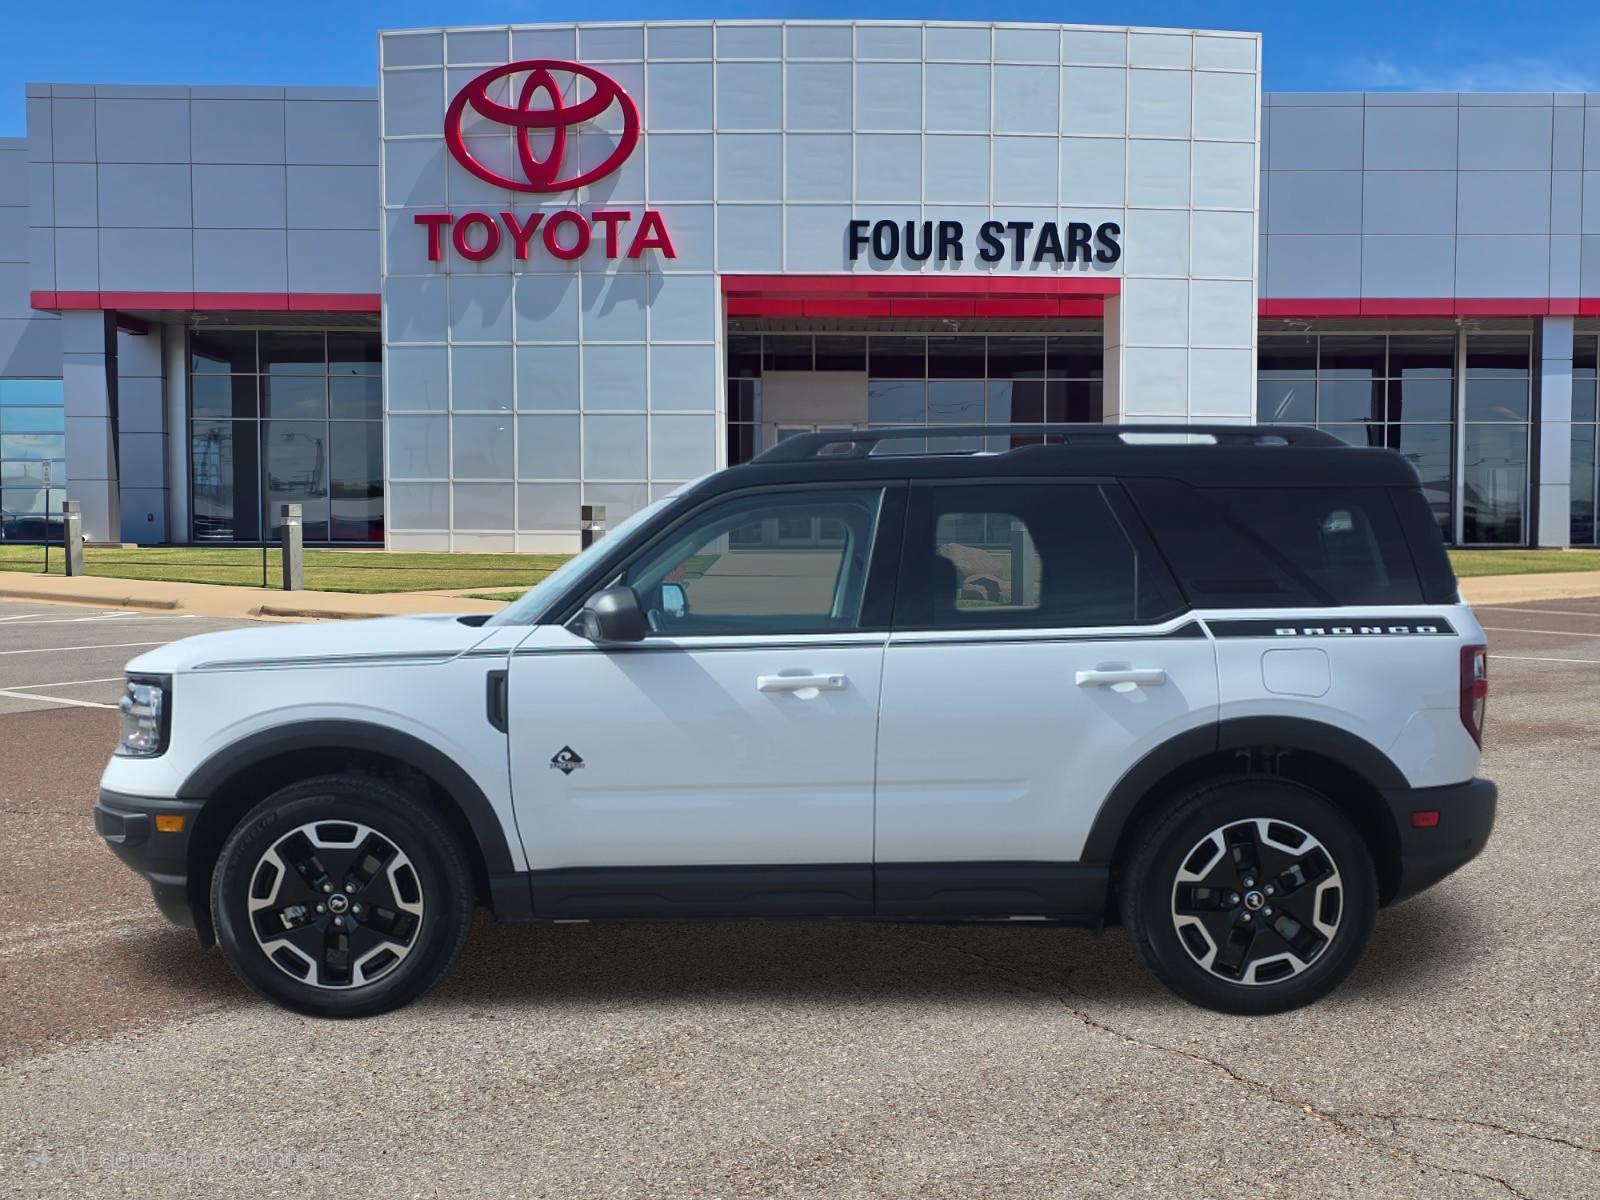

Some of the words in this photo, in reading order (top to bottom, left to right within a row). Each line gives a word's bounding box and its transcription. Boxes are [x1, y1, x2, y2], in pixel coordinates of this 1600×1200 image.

[415, 210, 676, 260] TOYOTA
[850, 220, 964, 261] FOUR
[979, 222, 1122, 263] STARS
[1275, 626, 1438, 635] BRONCO
